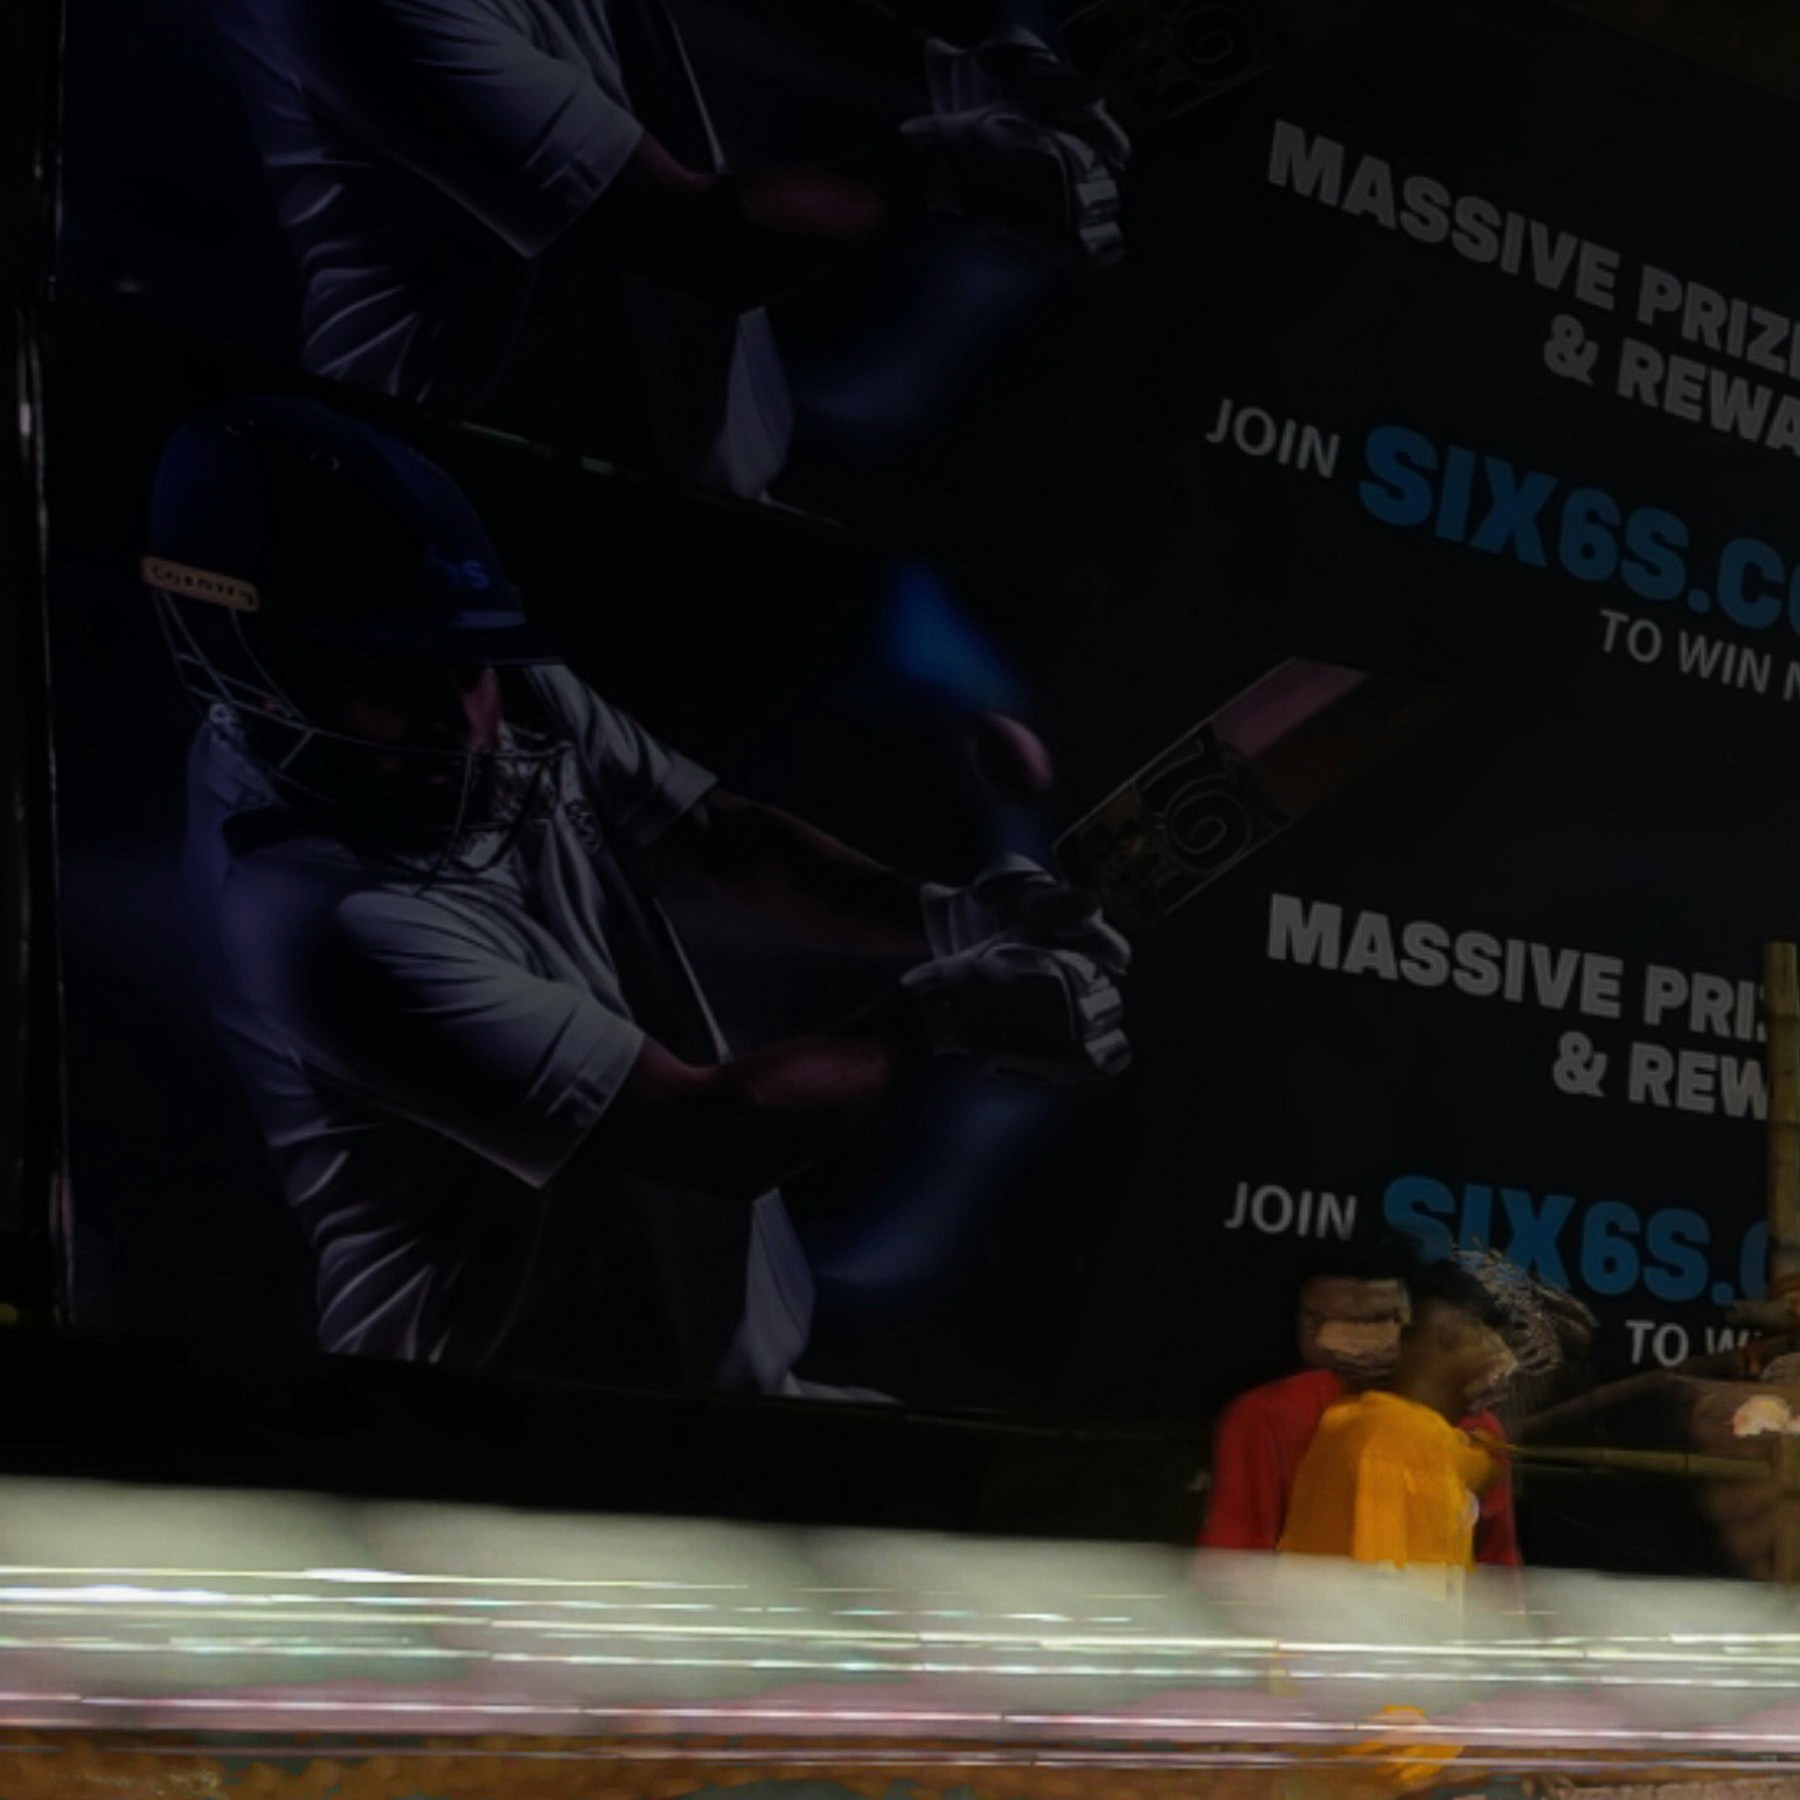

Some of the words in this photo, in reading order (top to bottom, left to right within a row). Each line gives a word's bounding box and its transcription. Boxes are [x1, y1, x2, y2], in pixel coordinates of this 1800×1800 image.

[1266, 117, 1622, 313] MASSIVE
[1543, 312, 1599, 387] &
[1205, 398, 1341, 480] JOIN
[1599, 608, 1663, 663] TO
[1677, 629, 1772, 694] WIN
[1265, 892, 1625, 1019] MASSIVE
[1552, 1029, 1609, 1098] &
[1224, 1181, 1358, 1241] JOIN
[1625, 1319, 1690, 1368] TO
